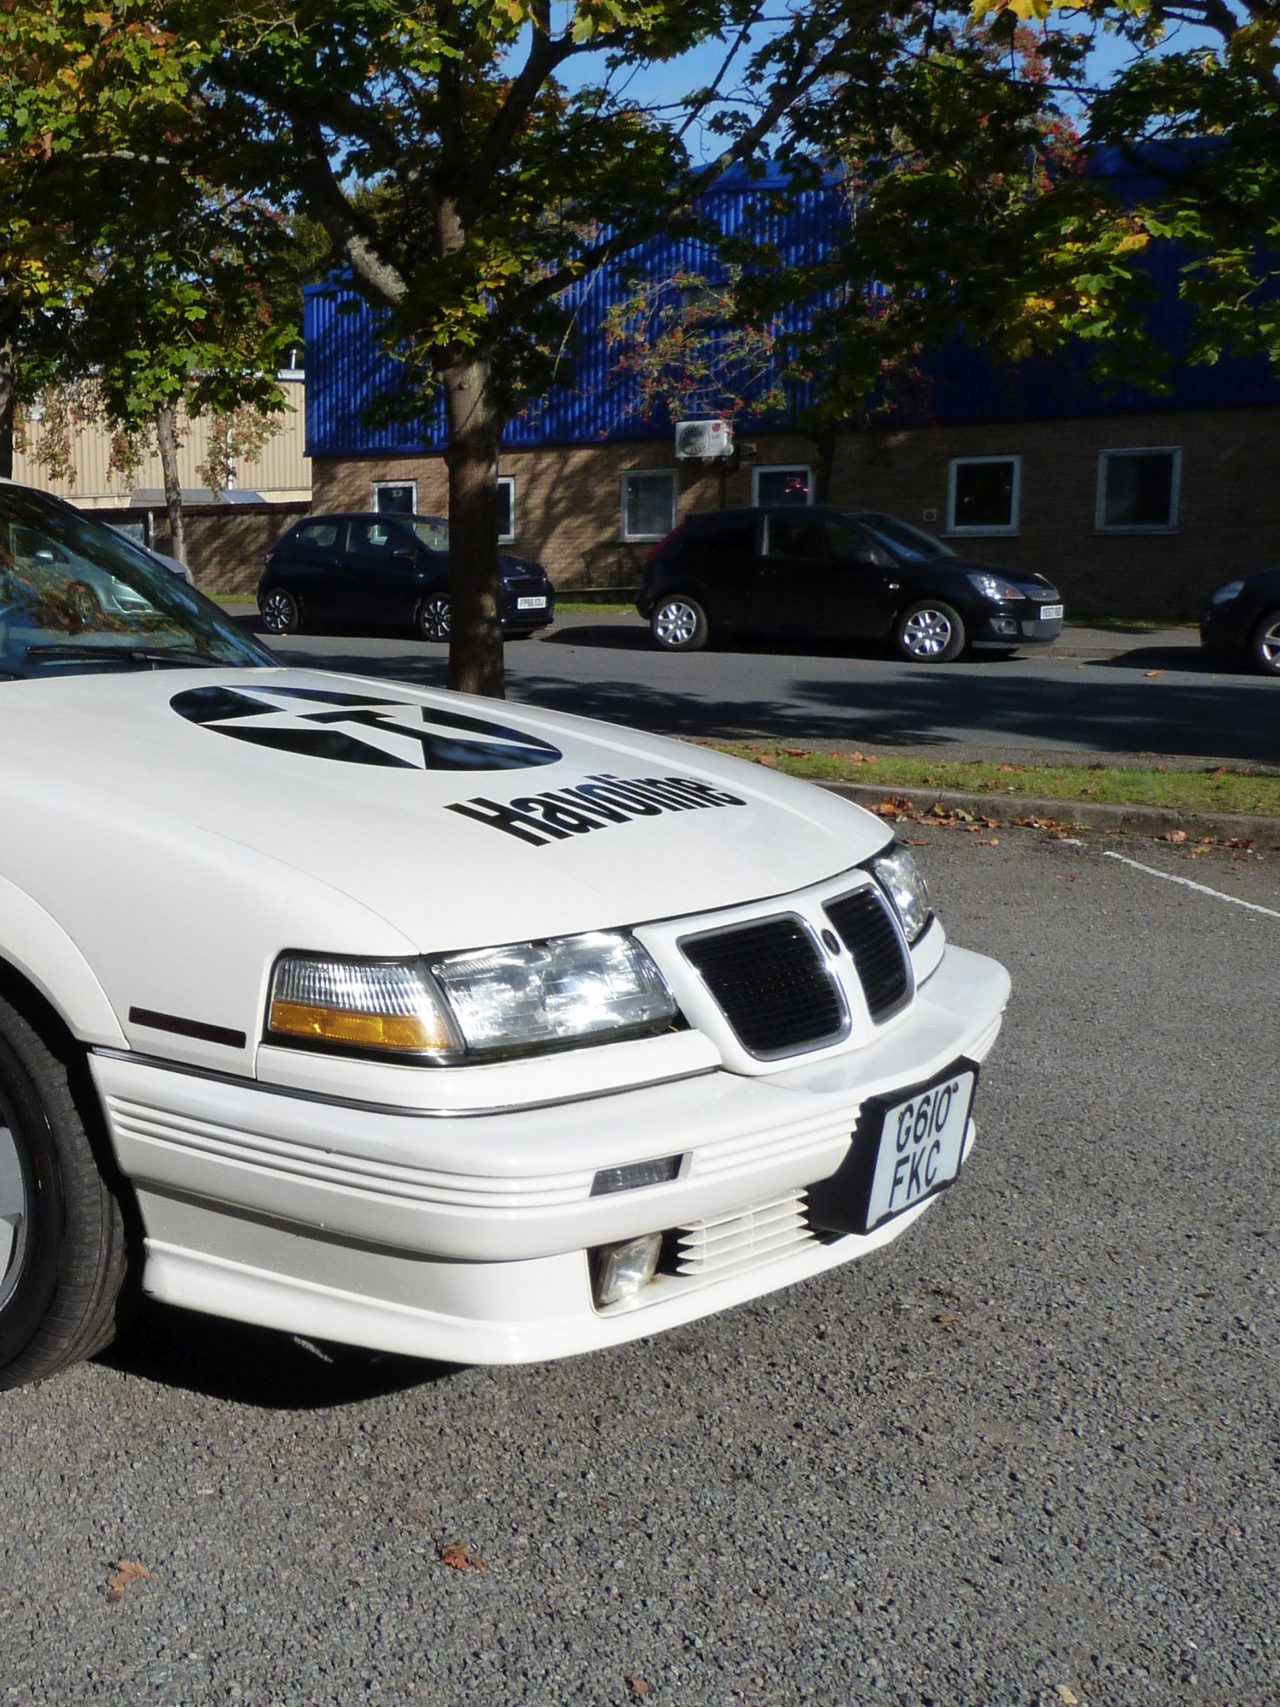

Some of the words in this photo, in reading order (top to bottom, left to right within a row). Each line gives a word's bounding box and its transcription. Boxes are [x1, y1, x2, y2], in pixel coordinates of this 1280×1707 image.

[442, 774, 747, 847] Havoline
[896, 1085, 952, 1153] G610
[888, 1139, 940, 1209] FKC
